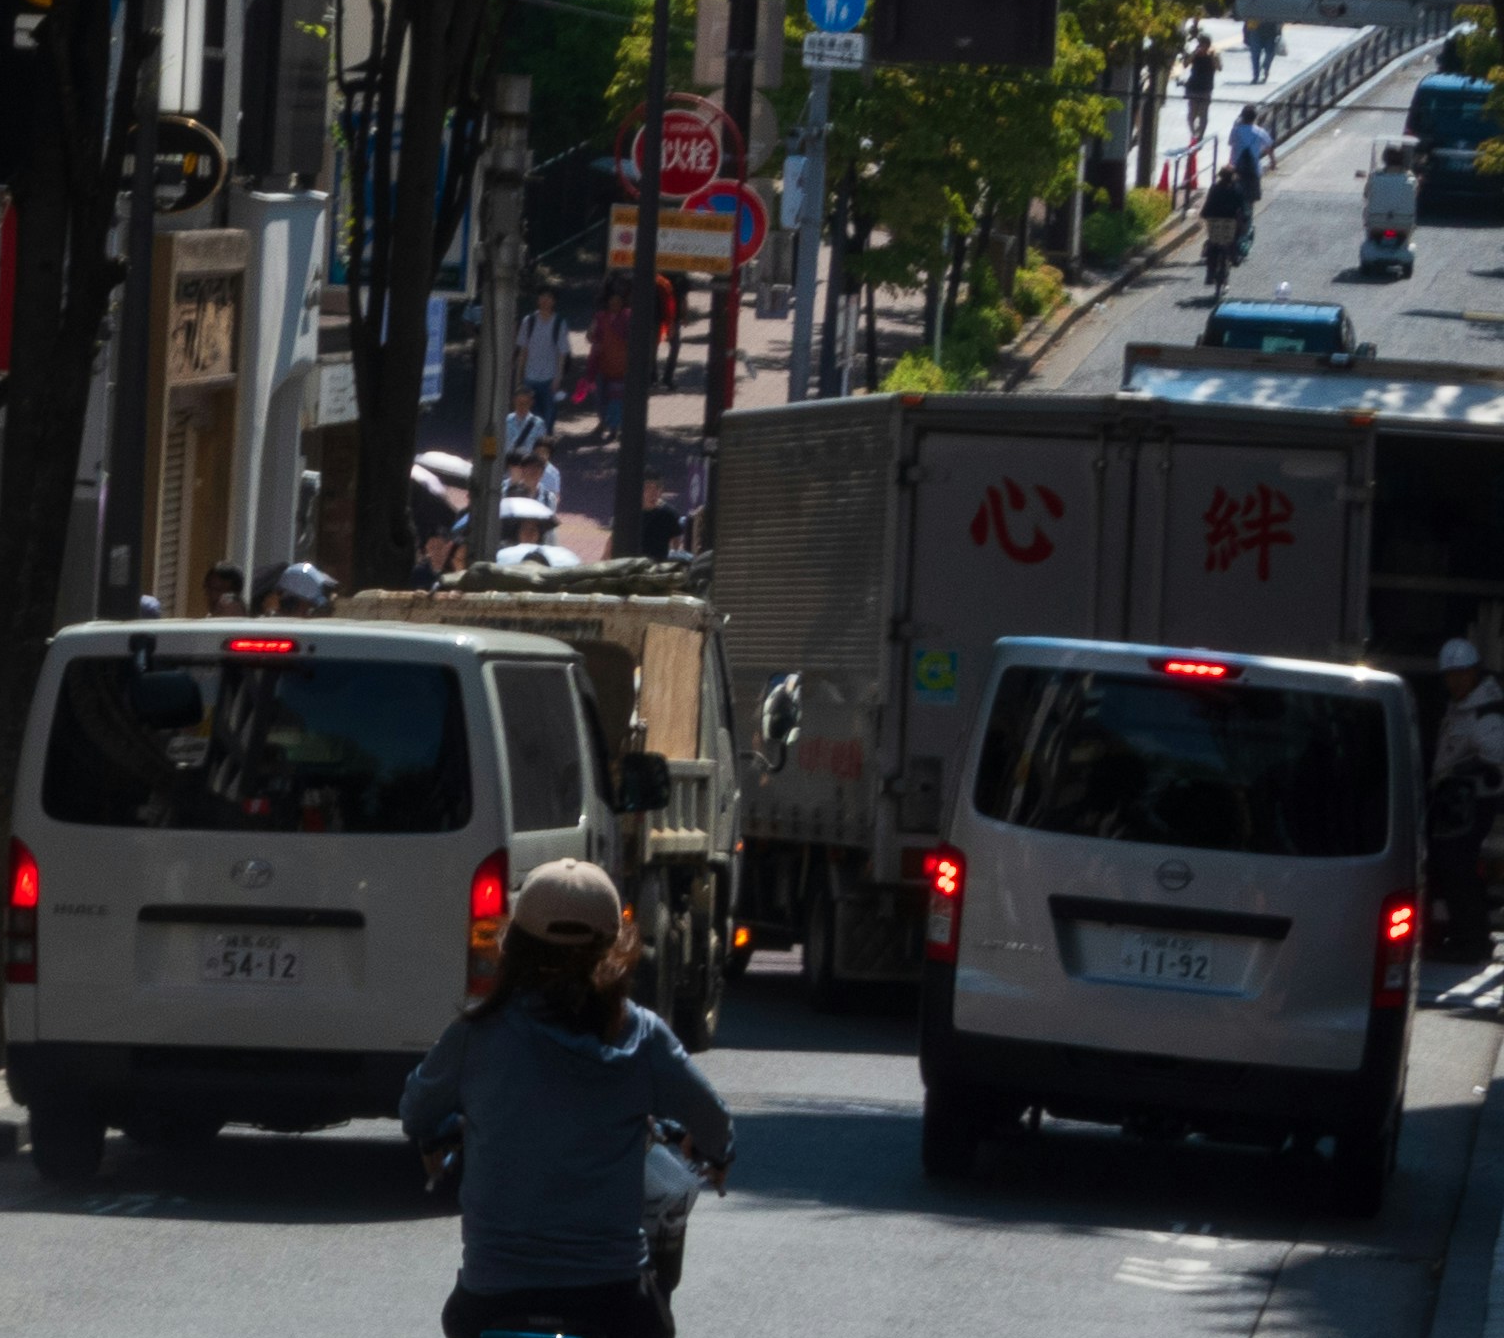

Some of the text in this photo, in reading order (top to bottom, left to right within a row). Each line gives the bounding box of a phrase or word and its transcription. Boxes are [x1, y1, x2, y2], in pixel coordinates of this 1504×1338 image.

[659, 136, 715, 174] 火栓
[969, 476, 1300, 583] 心 絆
[223, 950, 297, 978] 54-12
